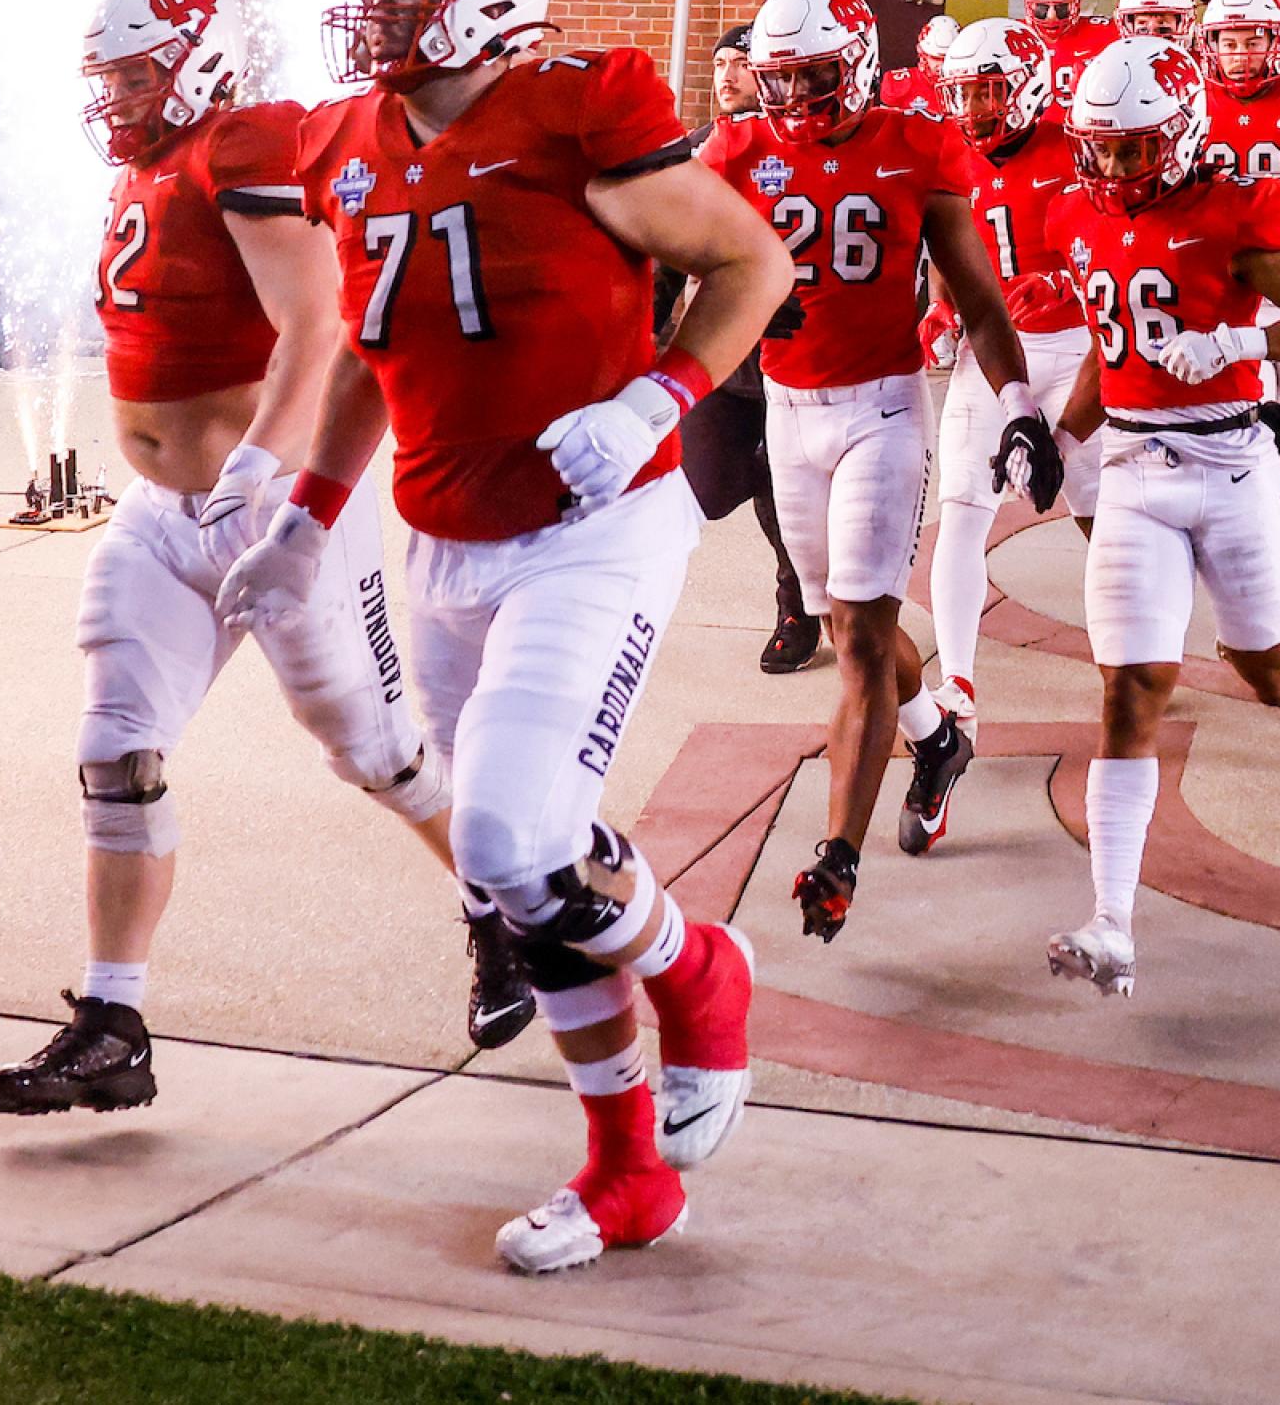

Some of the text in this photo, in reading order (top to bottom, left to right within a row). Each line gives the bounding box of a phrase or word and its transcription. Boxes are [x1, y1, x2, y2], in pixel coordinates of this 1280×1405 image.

[360, 200, 496, 349] 71
[773, 194, 886, 285] 26
[1086, 267, 1183, 369] 36
[359, 570, 403, 705] CARDINALS
[578, 613, 656, 777] CARDINALS
